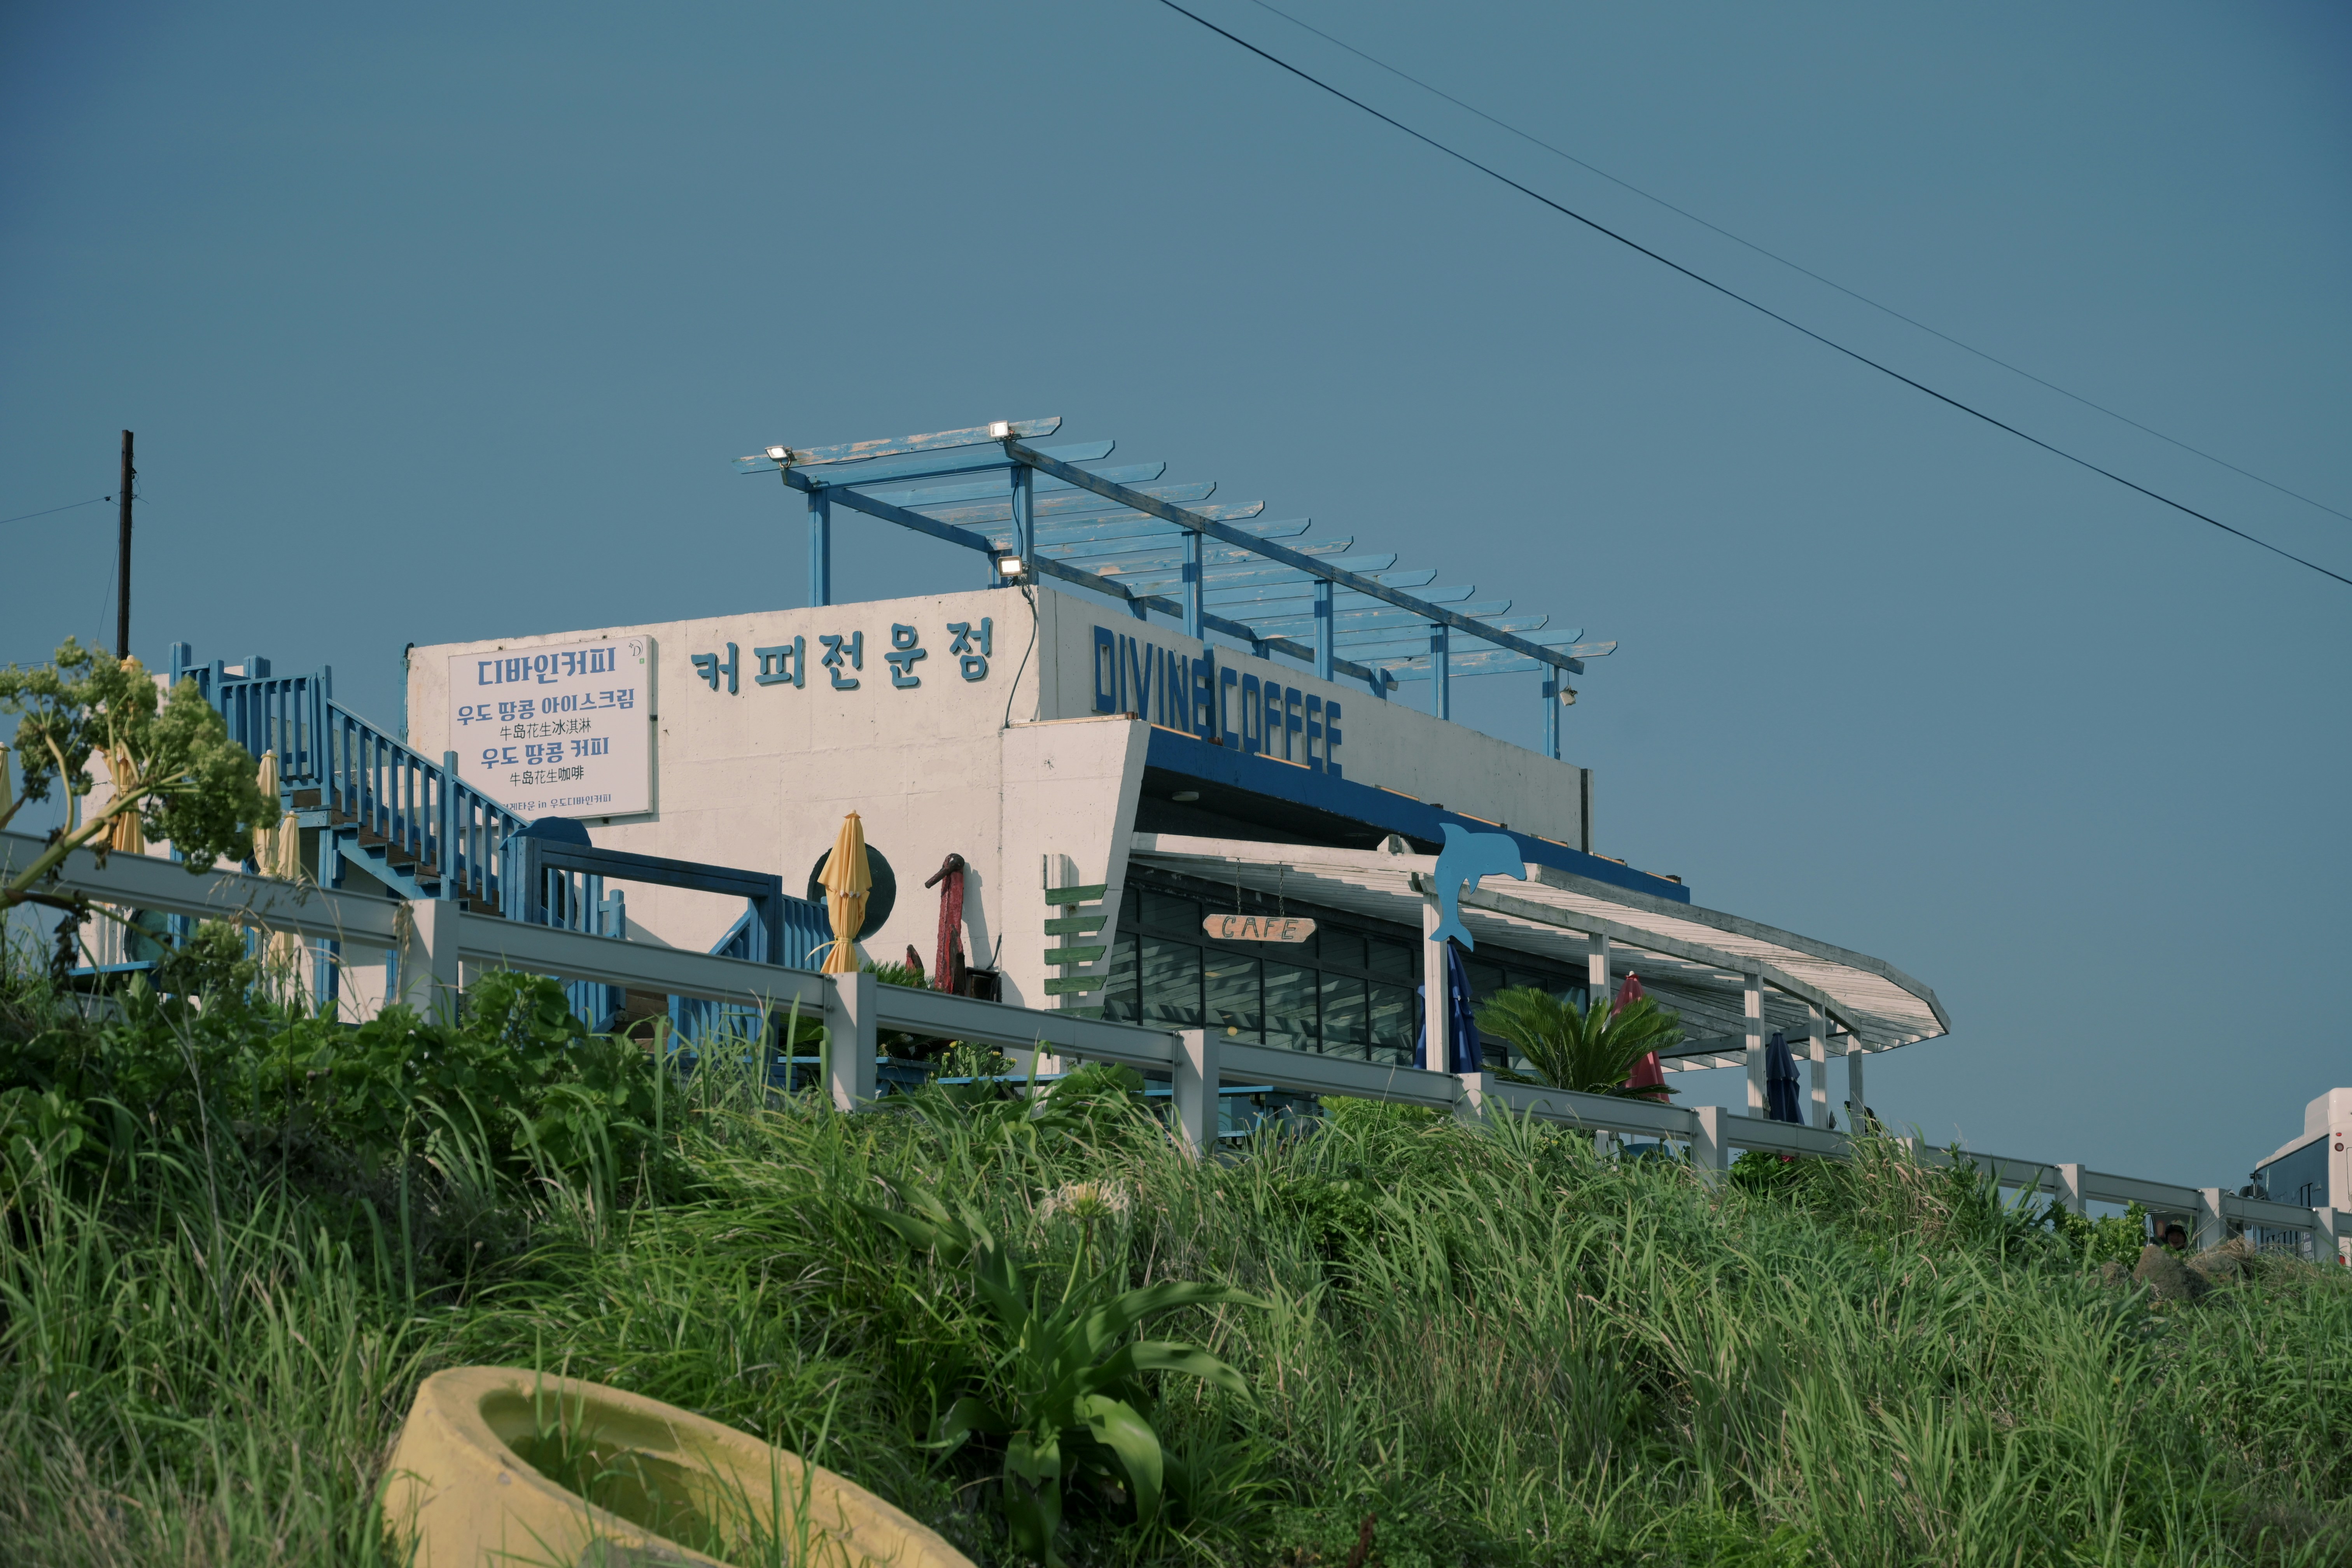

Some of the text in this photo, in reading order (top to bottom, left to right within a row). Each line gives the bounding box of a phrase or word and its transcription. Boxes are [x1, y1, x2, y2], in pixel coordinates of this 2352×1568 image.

[478, 647, 616, 685] 디바인커피
[691, 617, 990, 693] 커피전문점
[457, 688, 635, 725] 우도 땅콩 아이스크림
[1094, 625, 1342, 778] DIVINE COFFEE
[500, 718, 591, 741] 牛岛花生冰淇淋
[481, 737, 609, 768] 우도 땅콩 커피
[510, 765, 584, 787] 牛岛花生咖啡
[550, 794, 611, 808] 우도디바인커피
[1222, 915, 1298, 939] CAFE
